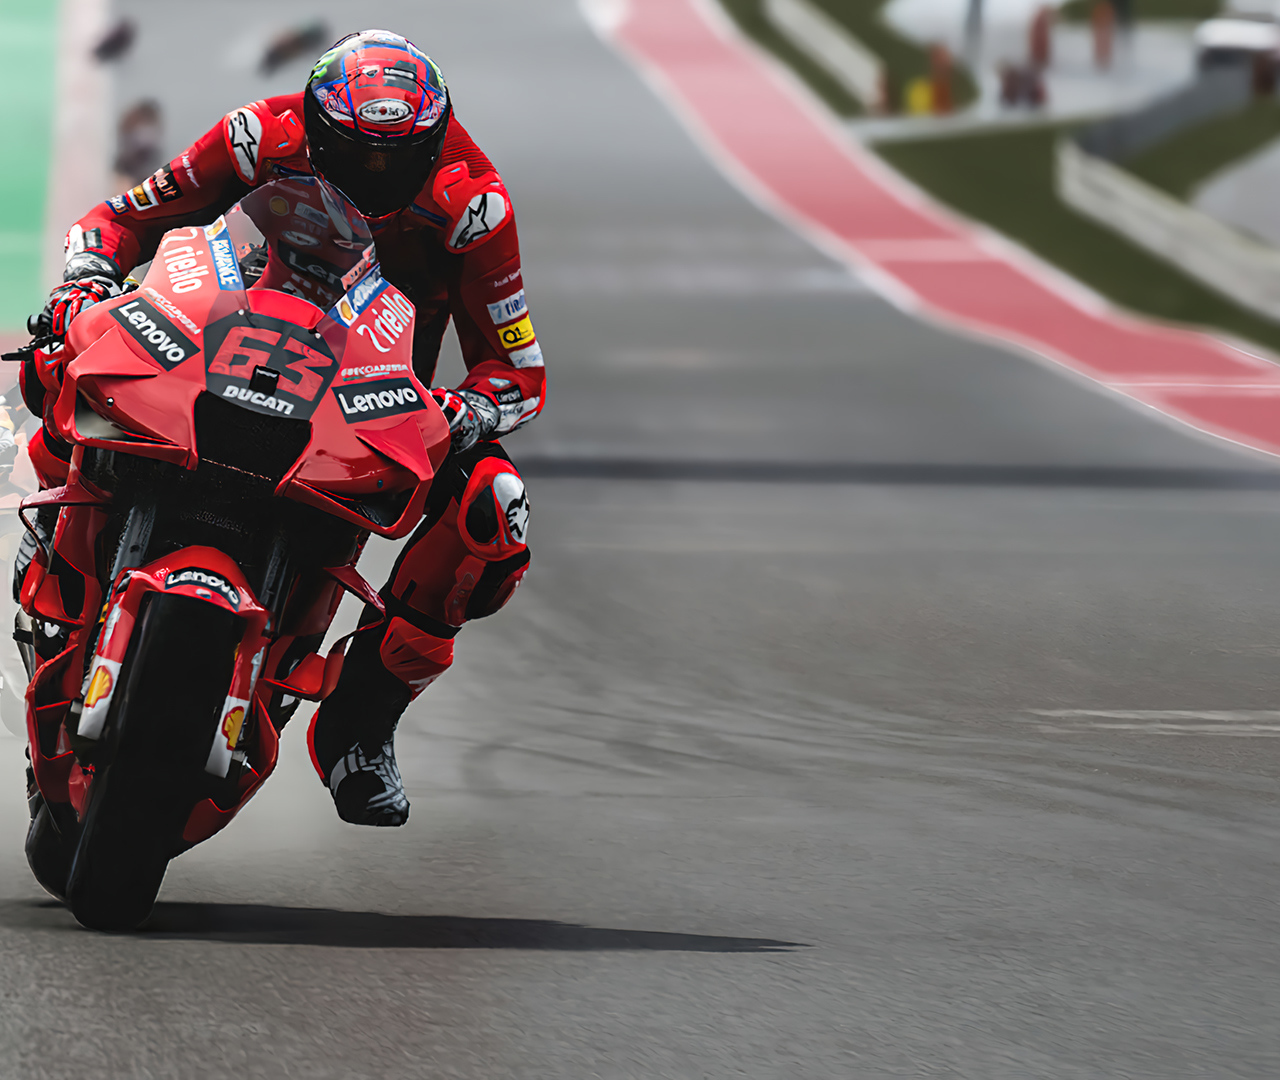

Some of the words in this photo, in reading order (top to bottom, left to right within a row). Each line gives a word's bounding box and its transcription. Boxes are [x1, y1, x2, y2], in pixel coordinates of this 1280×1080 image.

[163, 245, 210, 294] riello
[118, 301, 185, 362] Lenovo
[374, 292, 414, 345] riello
[207, 325, 334, 402] 63
[222, 384, 295, 415] DUCATI
[338, 387, 418, 415] Lenovo
[166, 570, 240, 605] Lenovo
